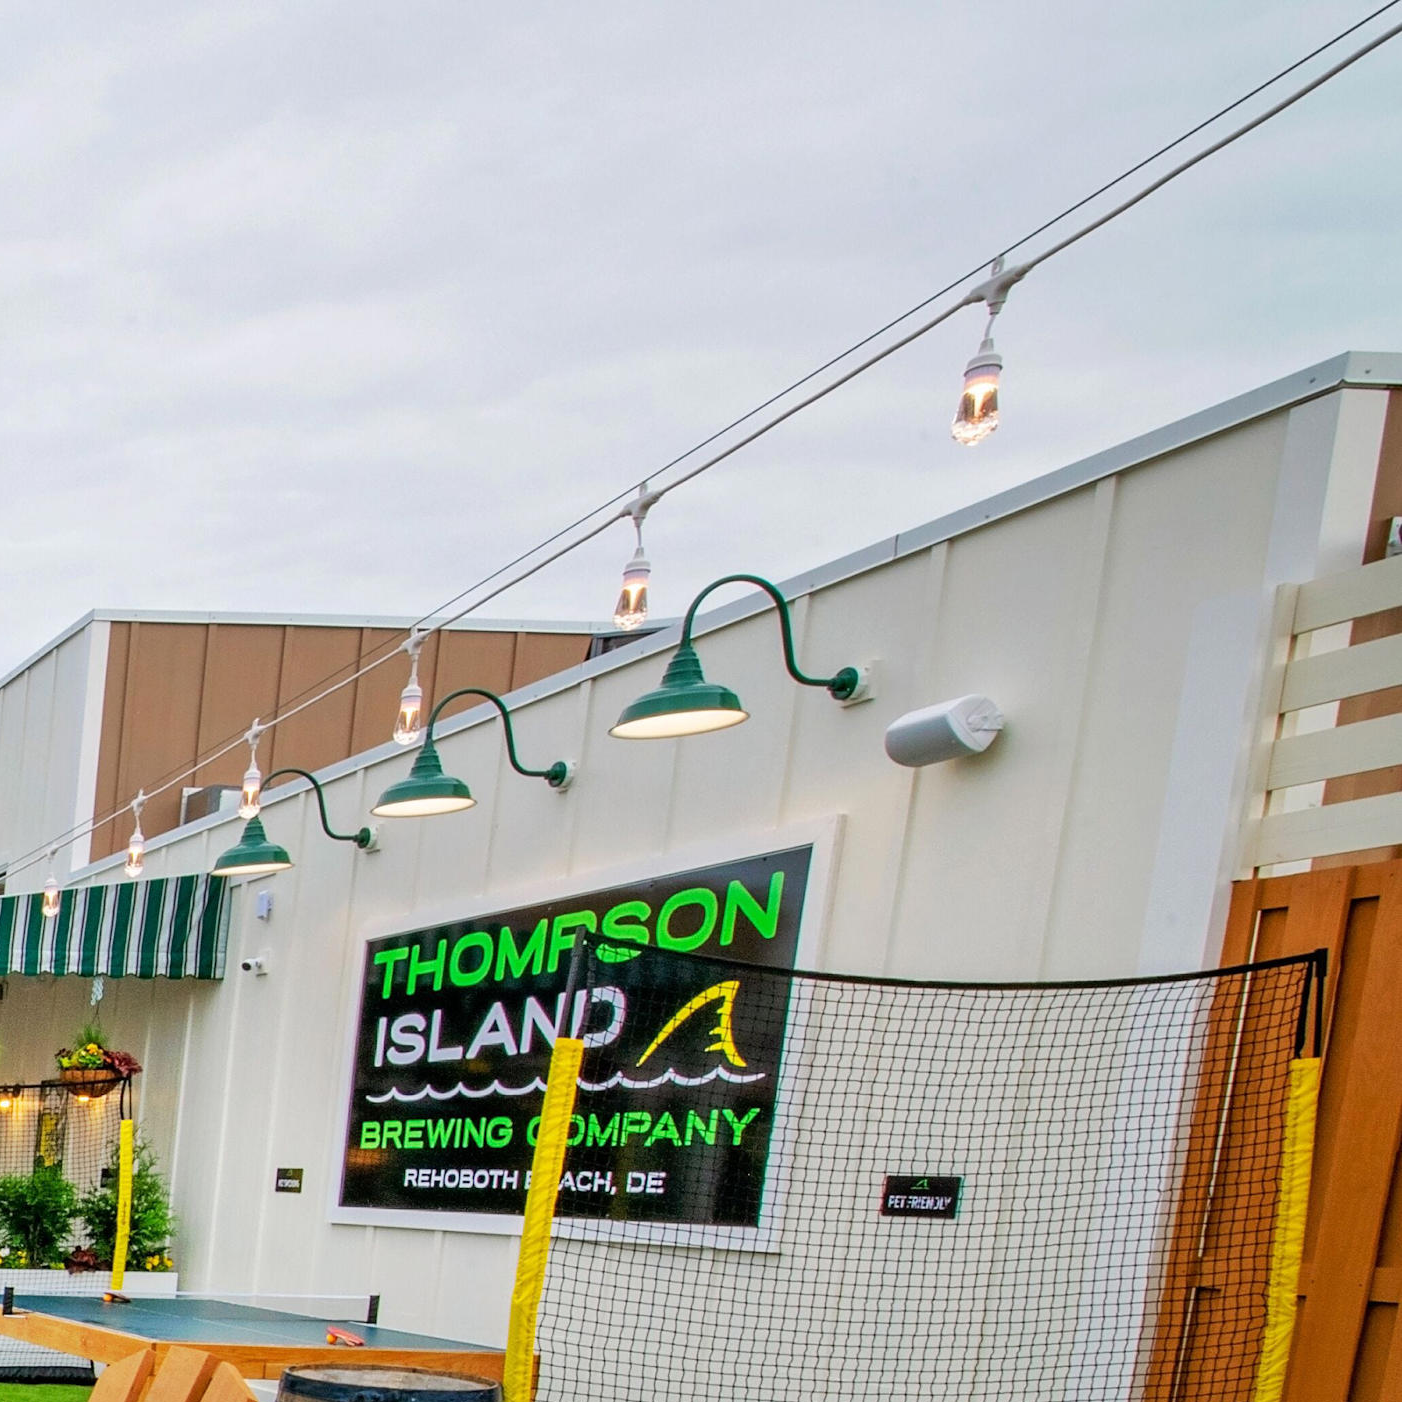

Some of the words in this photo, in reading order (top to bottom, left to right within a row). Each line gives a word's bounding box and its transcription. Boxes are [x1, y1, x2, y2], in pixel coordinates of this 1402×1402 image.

[374, 871, 784, 999] THOMPSON
[374, 985, 627, 1067] ISLAND
[360, 1116, 513, 1149] BREWING
[404, 1168, 518, 1190] REHOBOTH
[525, 1170, 617, 1195] ACH,
[626, 1172, 667, 1193] DE
[888, 1195, 907, 1208] PET
